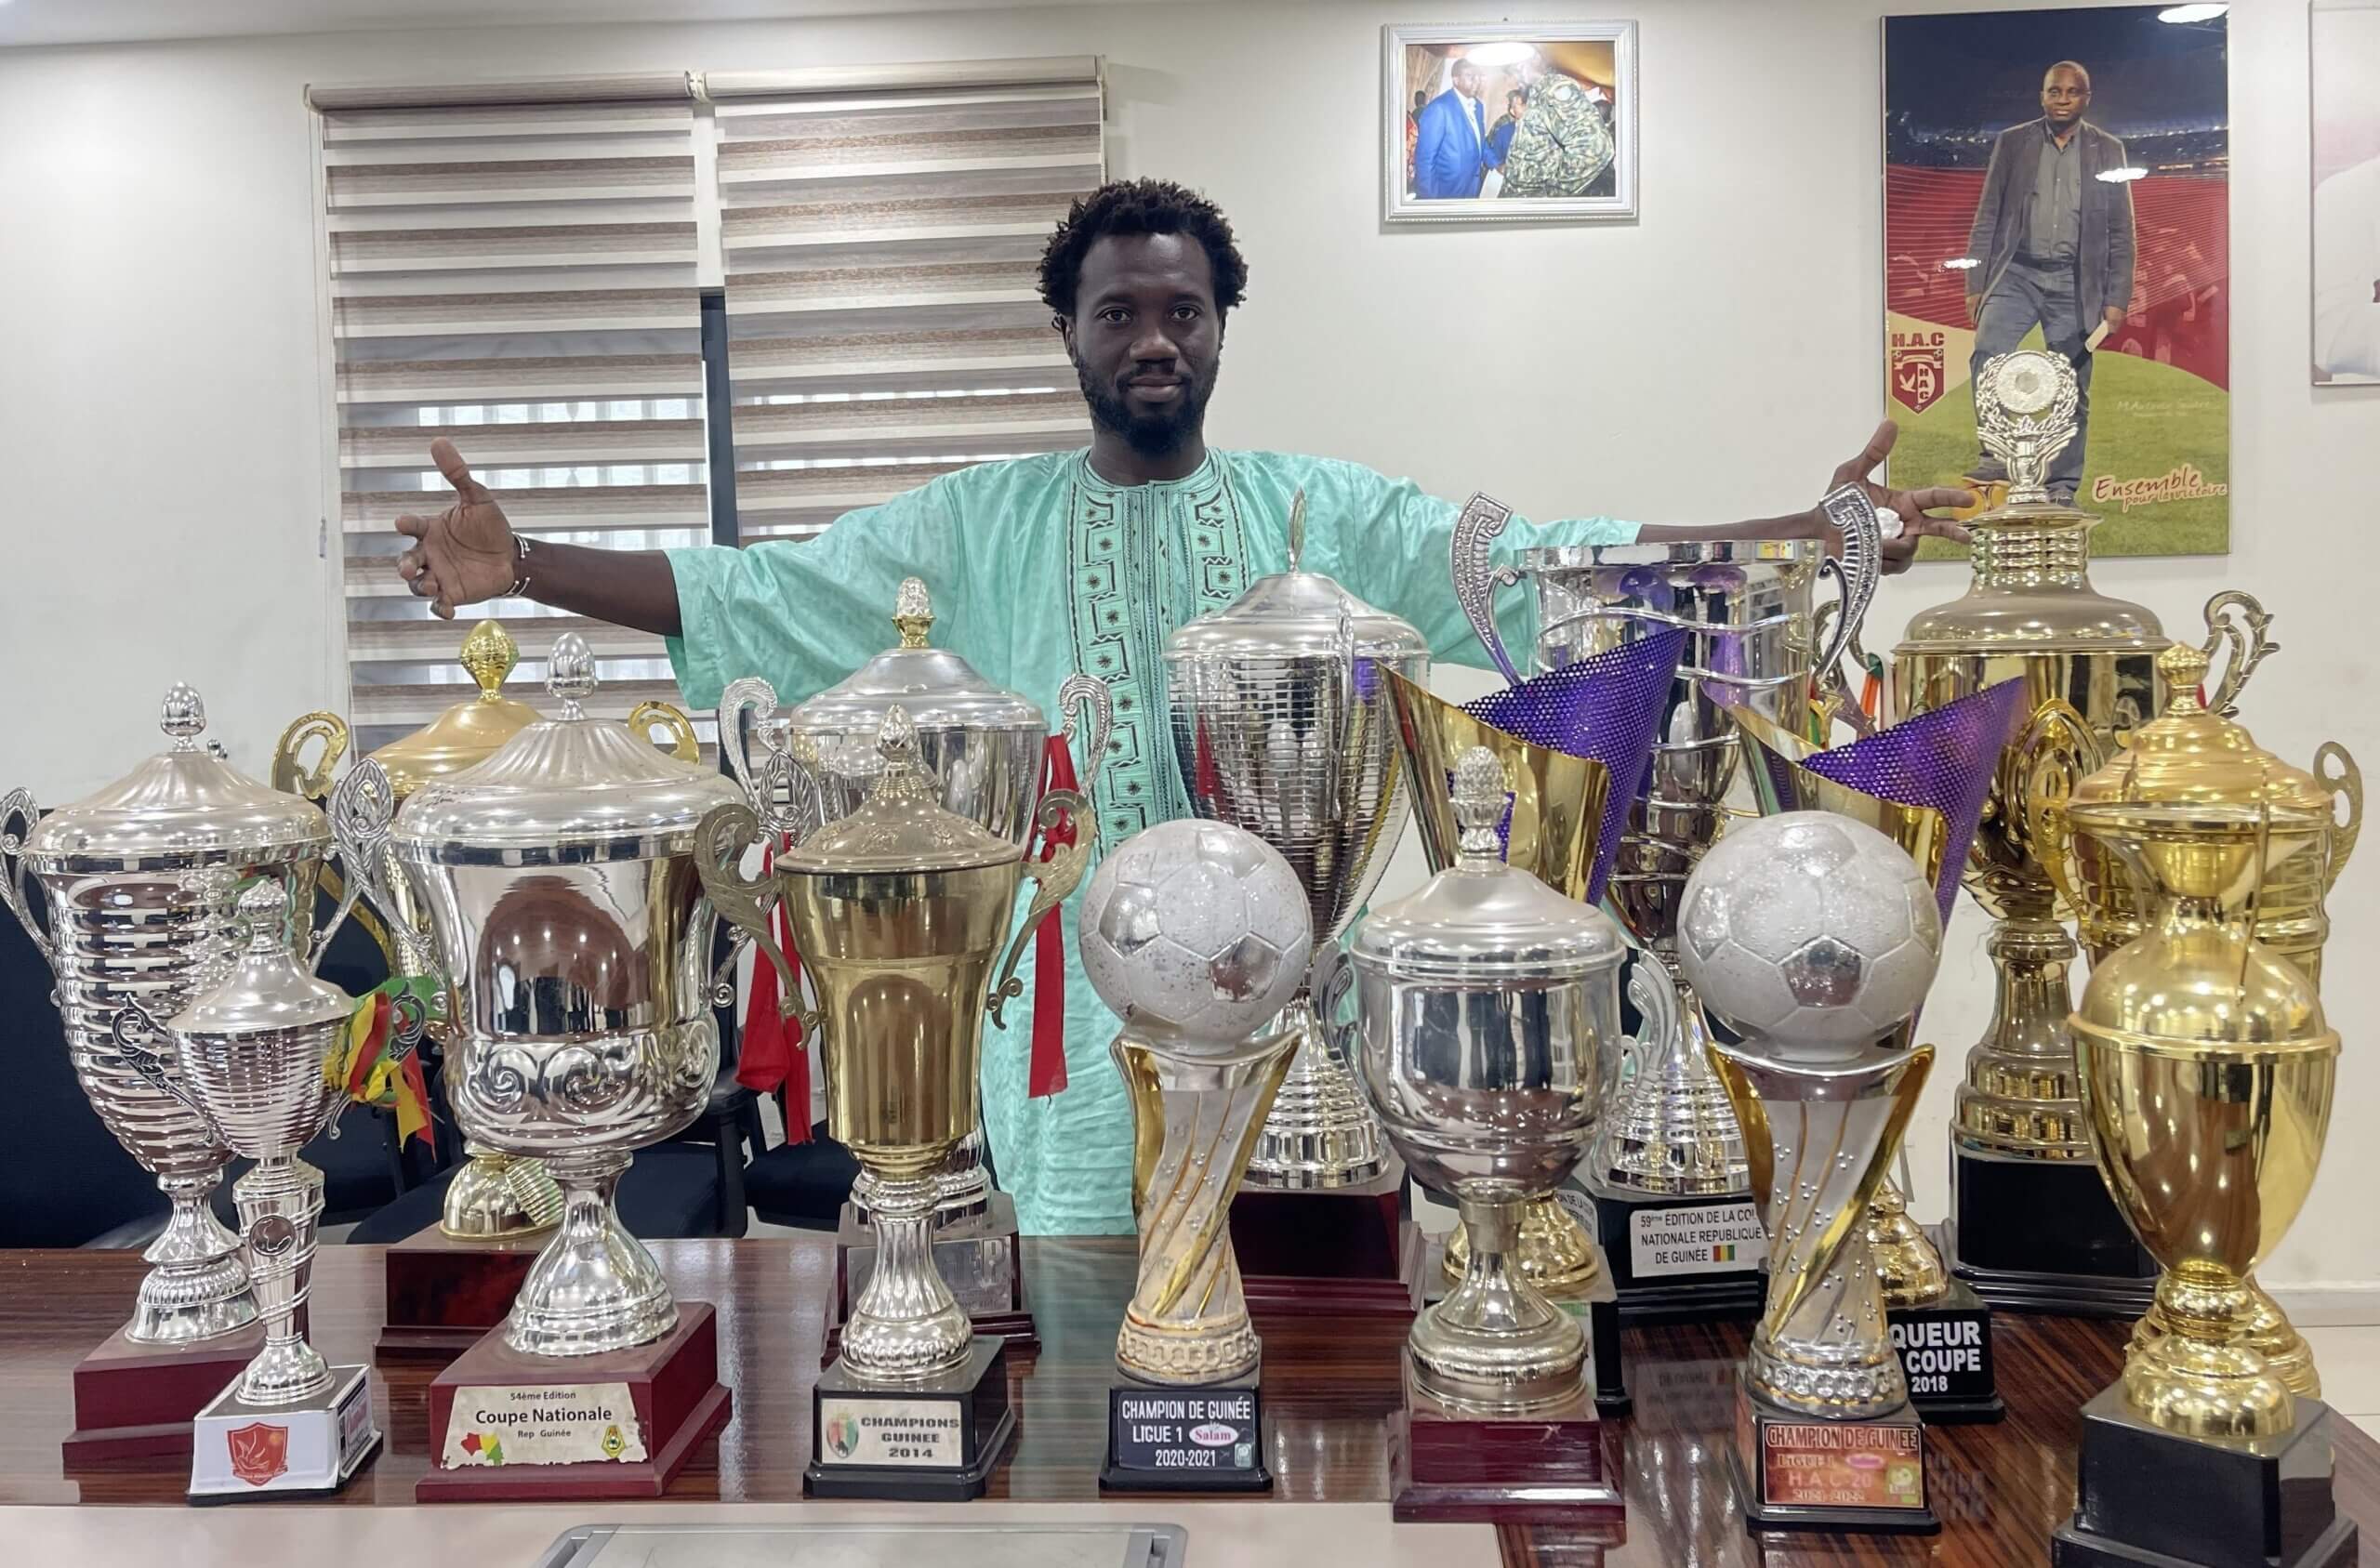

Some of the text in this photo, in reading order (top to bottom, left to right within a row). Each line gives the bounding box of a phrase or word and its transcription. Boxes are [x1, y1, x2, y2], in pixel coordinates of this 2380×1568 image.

[1891, 332, 1945, 347] H.A.C
[1919, 368, 1929, 400] HAC
[2096, 467, 2200, 500] Ensemble
[2123, 493, 2153, 509] pour
[2172, 484, 2228, 500] victoire
[1665, 1210, 1704, 1226] ÉDITION
[1706, 1211, 1720, 1224] DE
[1722, 1210, 1735, 1223] LA
[1641, 1226, 1762, 1246] NATIONALE REPUBLIQUE
[1655, 1246, 1709, 1264] DE GUINÉE
[1888, 1321, 1983, 1350] QUEUR
[1906, 1348, 1982, 1374] COUPE
[1911, 1376, 1949, 1393] 2018
[509, 1390, 576, 1402] 54ème Edition
[475, 1405, 613, 1428] Coupe Nationale
[1122, 1395, 1251, 1420] CHAMPION DE GUINÉE
[860, 1416, 960, 1429] CHAMPIONS
[517, 1427, 572, 1441] Rep Guinée
[880, 1432, 941, 1443] GUINEE
[1132, 1425, 1232, 1443] LIGUE 1 Salam
[1767, 1426, 1842, 1449] CHAMPION
[1844, 1427, 1866, 1449] DE
[888, 1447, 934, 1458] 2014
[1155, 1449, 1216, 1467] 2020-2021
